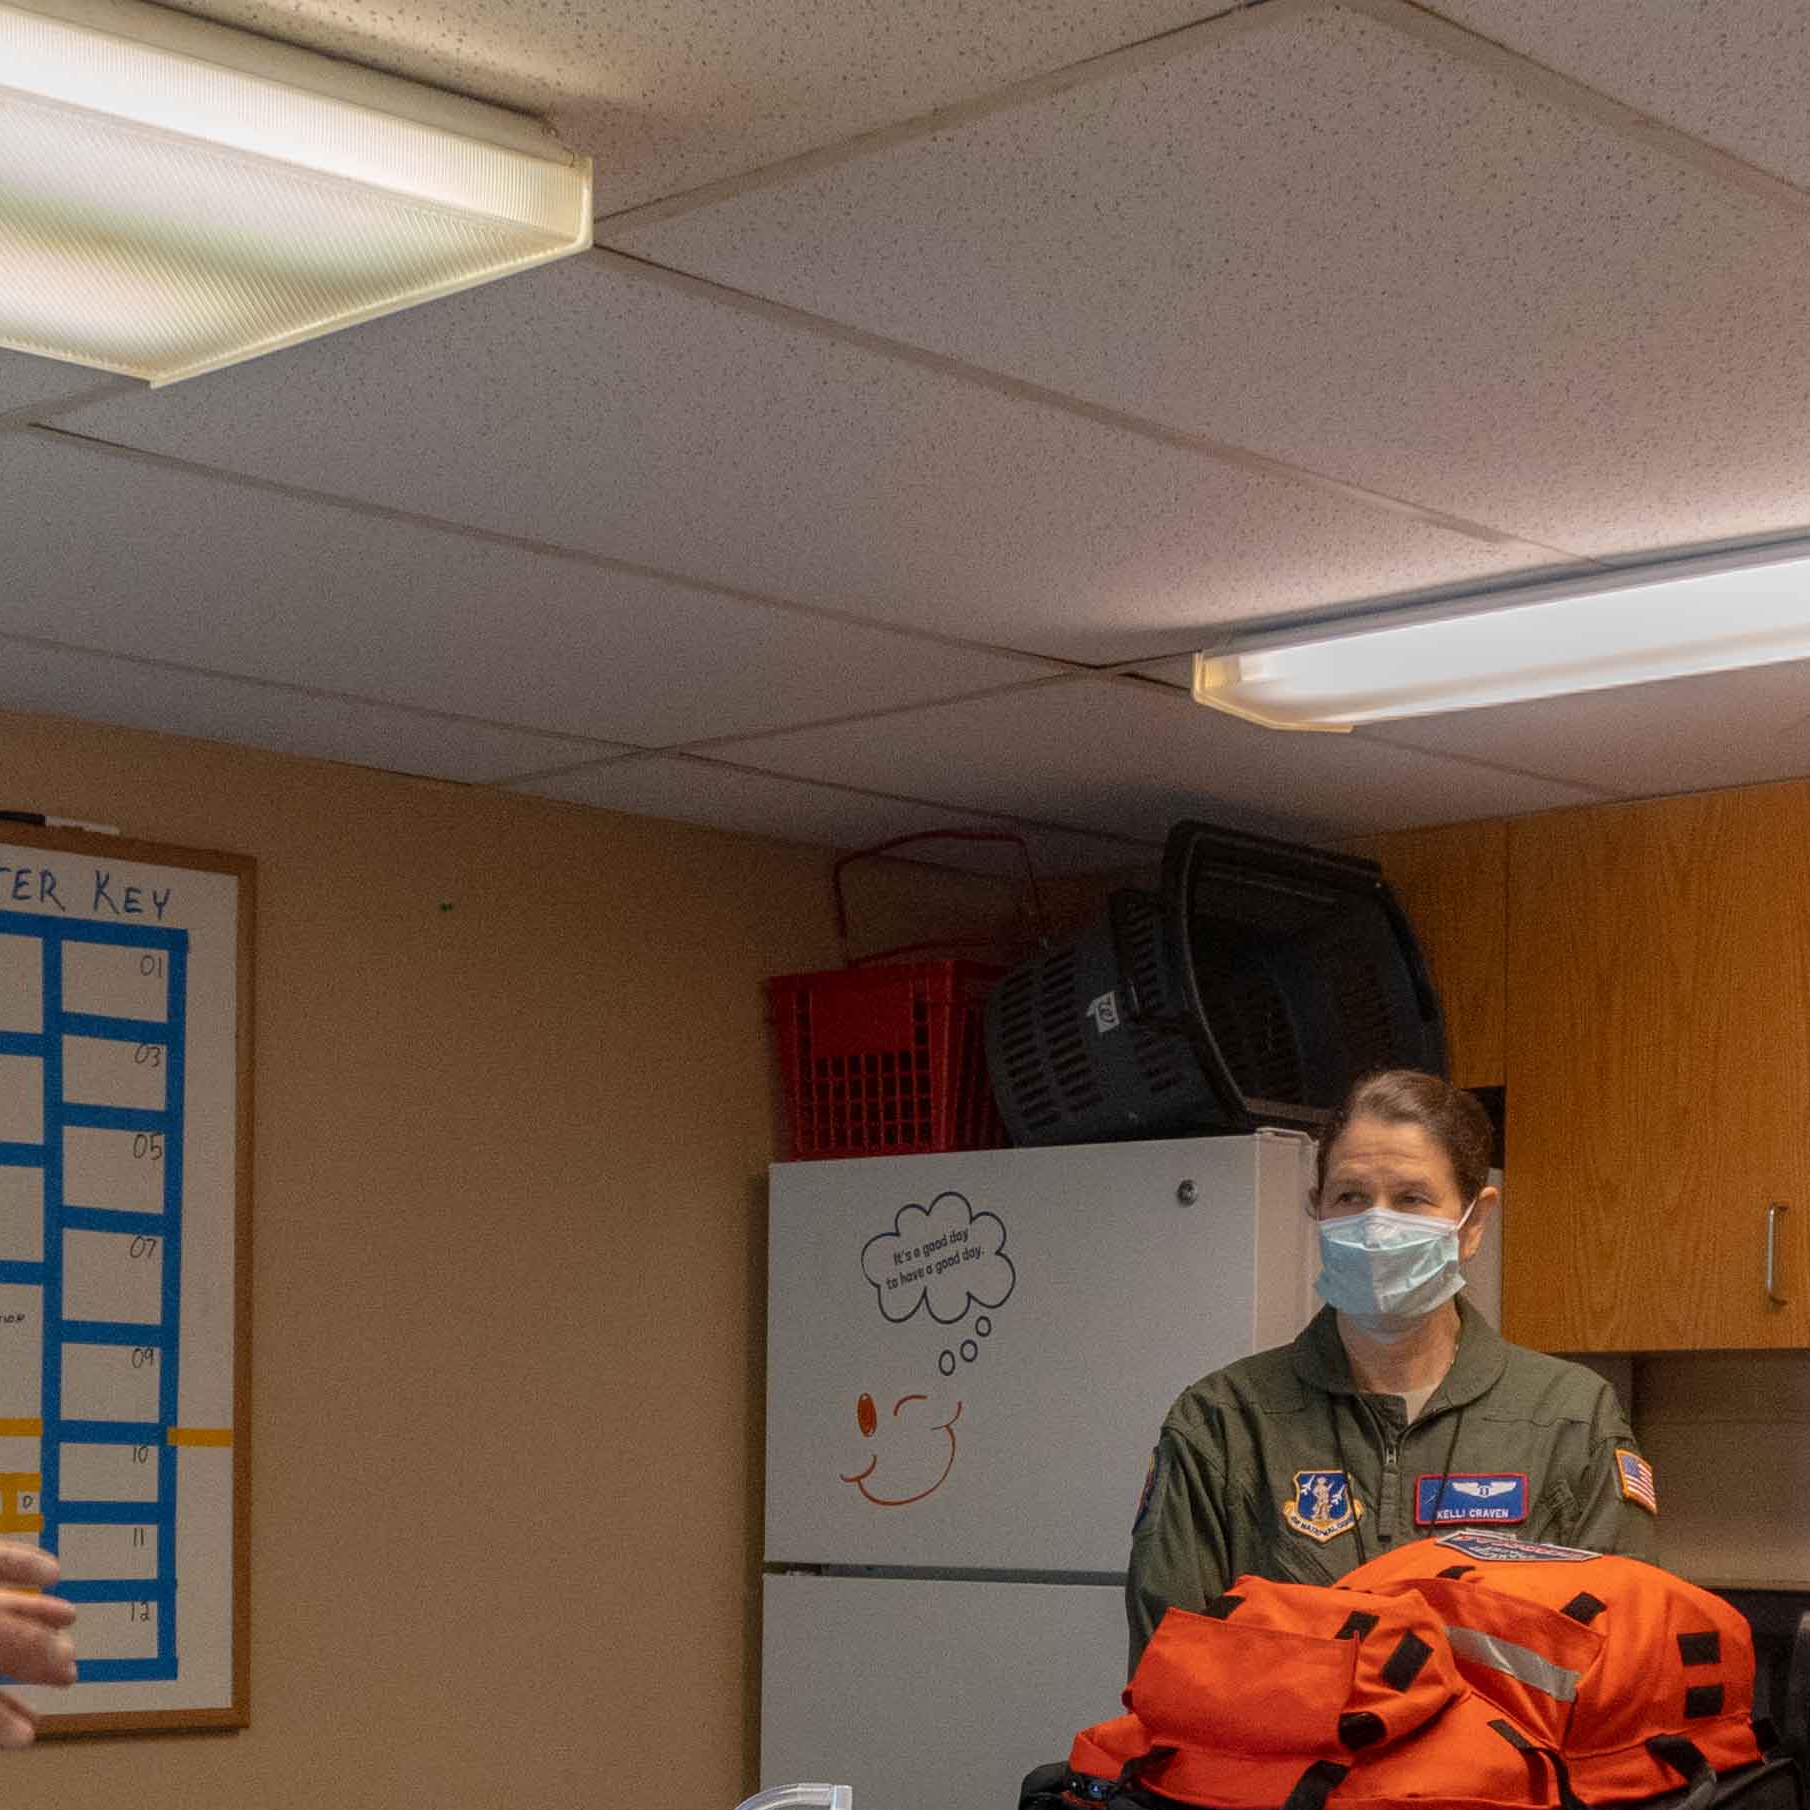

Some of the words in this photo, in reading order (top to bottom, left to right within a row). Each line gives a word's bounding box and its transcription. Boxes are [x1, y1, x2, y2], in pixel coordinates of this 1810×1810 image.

[94, 867, 173, 920] KEY
[138, 953, 163, 978] 01
[133, 1043, 163, 1068] 03
[132, 1133, 162, 1162] 05
[128, 1235, 157, 1260] 07
[893, 1250, 913, 1266] It's
[913, 1247, 921, 1258] a
[922, 1233, 948, 1257] good
[949, 1228, 970, 1247] day
[885, 1278, 899, 1290] to
[899, 1268, 925, 1286] have
[926, 1264, 934, 1275] a
[934, 1254, 961, 1275] good
[130, 1346, 155, 1370] 09
[1435, 1507, 1465, 1521] KELLI
[1468, 1506, 1509, 1519] CRAVEN
